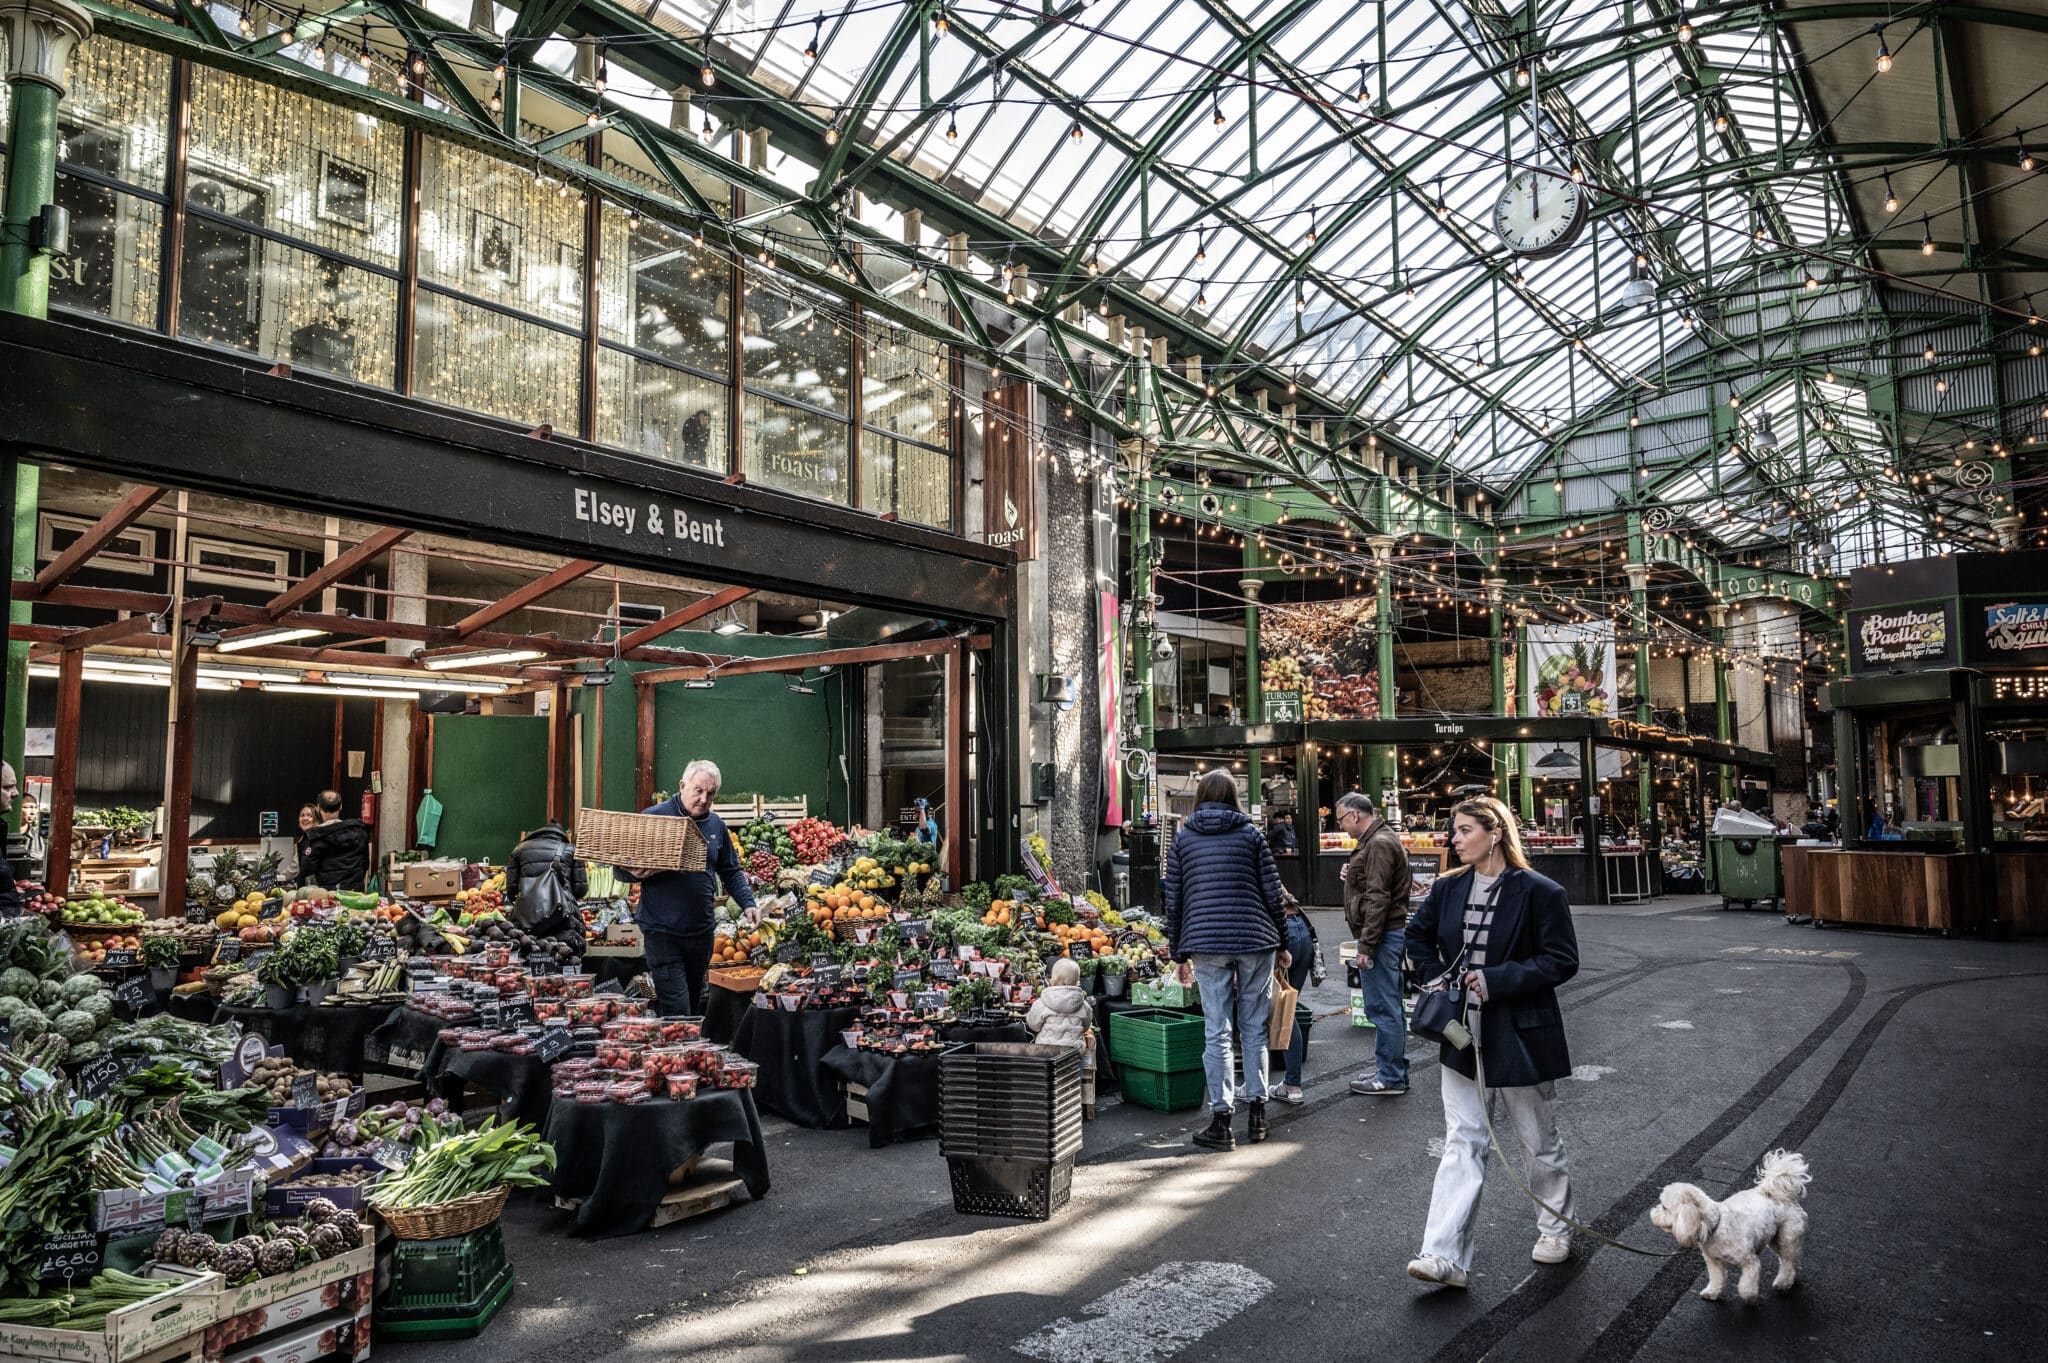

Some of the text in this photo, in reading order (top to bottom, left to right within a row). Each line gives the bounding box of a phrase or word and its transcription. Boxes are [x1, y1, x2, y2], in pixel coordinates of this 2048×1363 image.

[772, 454, 821, 482] roast
[574, 487, 725, 548] Elsey & Bent
[987, 526, 1025, 546] roast
[1870, 610, 1928, 630] Bomba
[1994, 607, 2041, 625] Salt &
[1869, 627, 1921, 647] Paella
[1264, 691, 1299, 700] TURNIPS
[1434, 722, 1464, 735] Turnips
[505, 1007, 524, 1022] £2
[86, 1062, 119, 1093] £1.50
[44, 1239, 98, 1250] COURGETTE
[52, 1232, 97, 1241] SICILIAN
[41, 1251, 99, 1273] £6.80
[254, 1260, 350, 1299] The Kingdom of quality
[11, 1333, 48, 1350] Kingdom
[48, 1337, 57, 1351] of
[60, 1339, 91, 1357] quality
